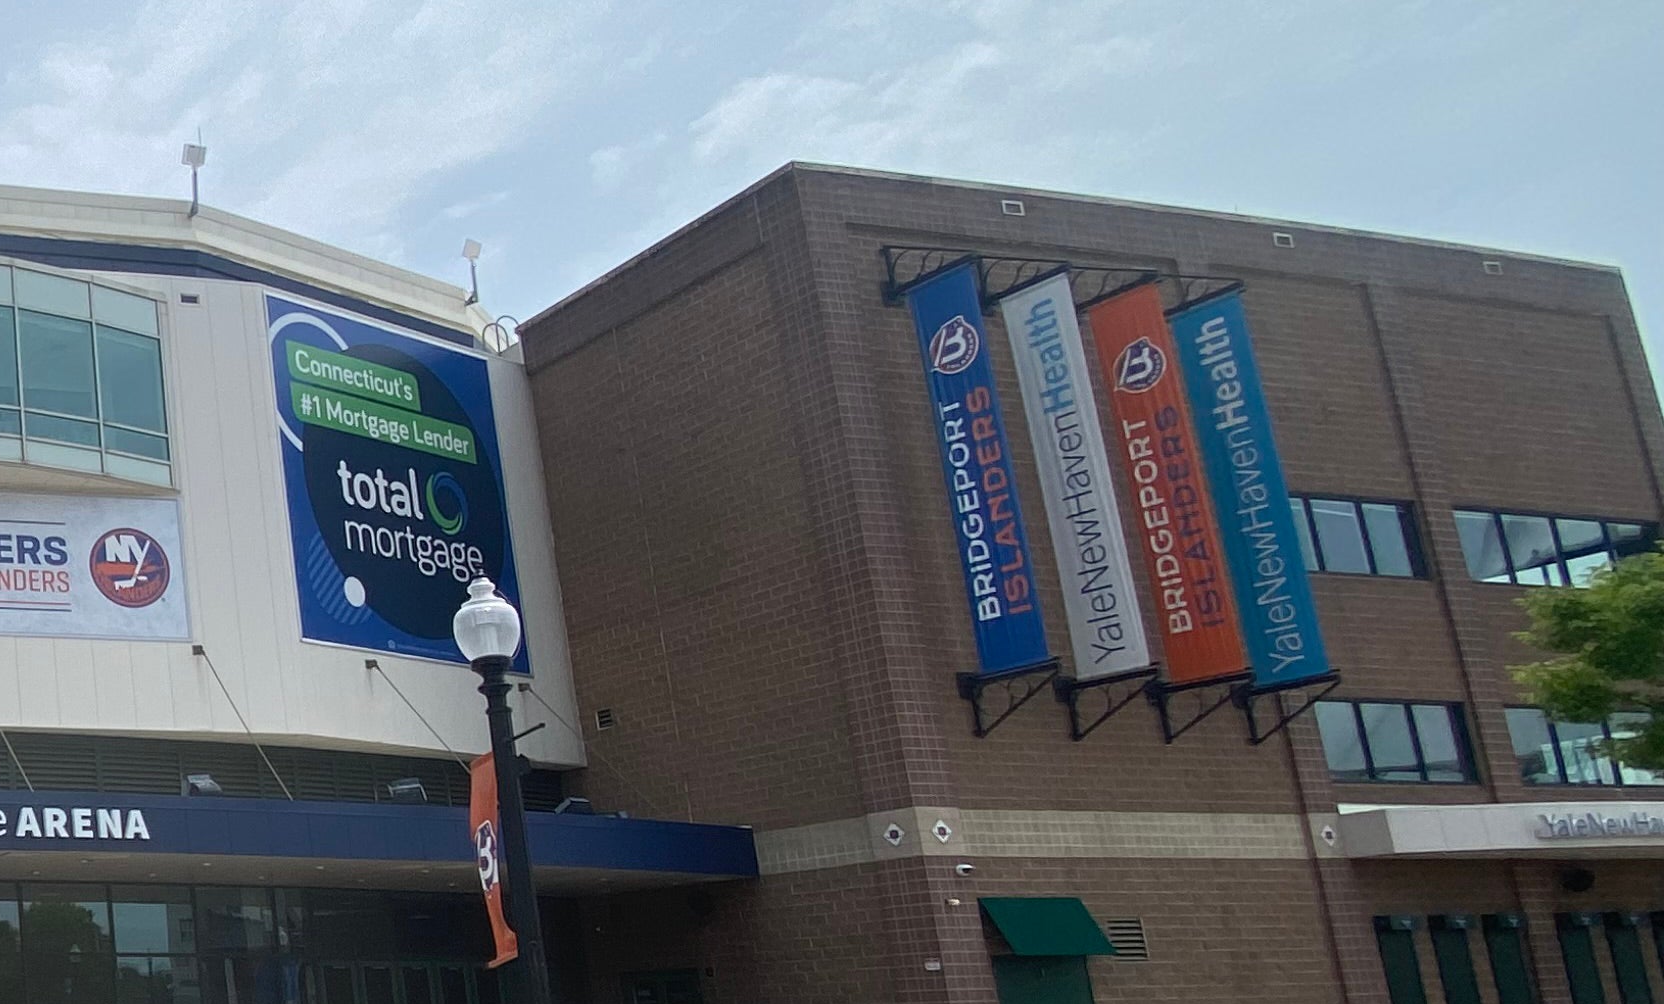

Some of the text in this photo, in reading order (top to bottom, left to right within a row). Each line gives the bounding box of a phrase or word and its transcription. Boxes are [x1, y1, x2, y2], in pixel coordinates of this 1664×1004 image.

[295, 350, 413, 401] Connecticut's
[301, 393, 469, 456] #1 Mortgage Lender
[337, 460, 423, 521] total
[939, 400, 1001, 622] BRIDGEPORT
[966, 386, 1033, 615] ISLANDERS
[1154, 405, 1224, 627] ISLANDERS
[344, 518, 483, 582] mortgage
[1122, 418, 1193, 634] BRIDGEPORT
[15, 806, 150, 840] ARENA
